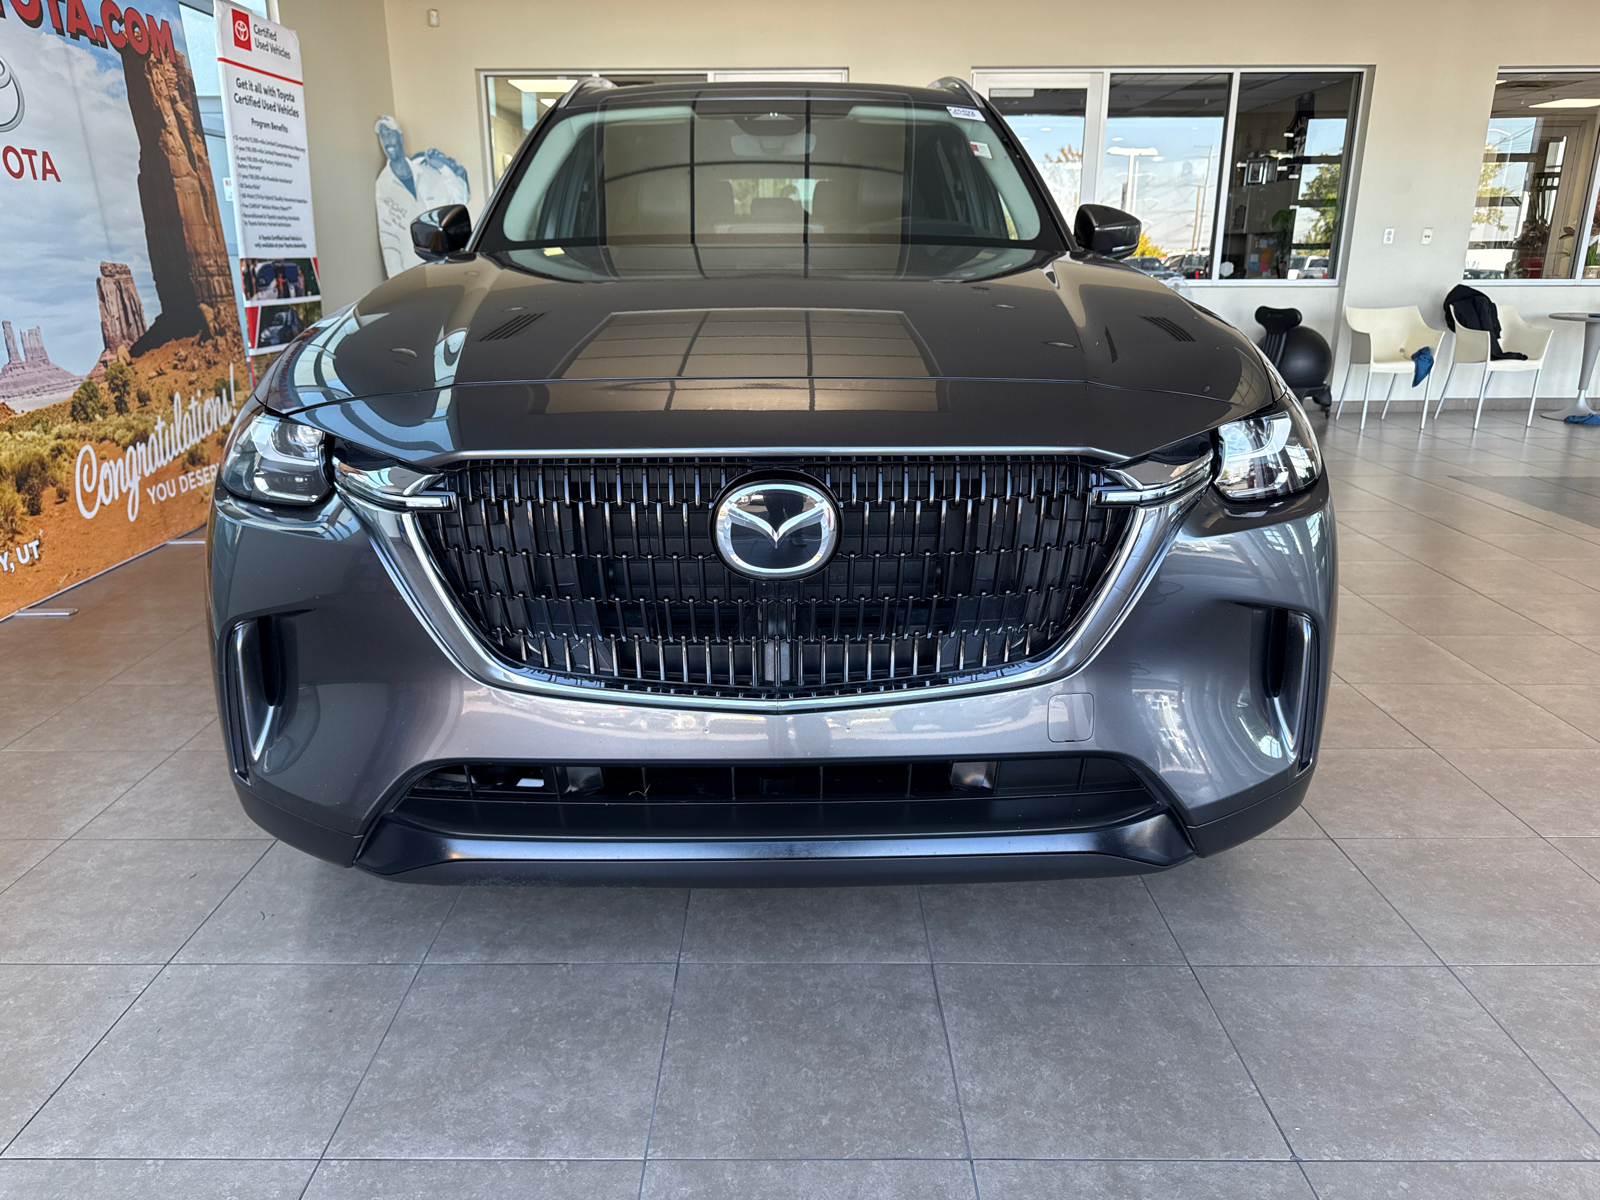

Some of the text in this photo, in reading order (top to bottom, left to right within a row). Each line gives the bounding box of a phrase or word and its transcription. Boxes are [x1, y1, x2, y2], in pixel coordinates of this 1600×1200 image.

[253, 24, 278, 41] Certified
[254, 38, 291, 60] Used Vehicles
[235, 77, 295, 103] Get it all with Toyota
[233, 92, 300, 118] Certified Used Vehicles
[251, 117, 289, 133] Program Benefits
[75, 362, 238, 522] Congratulations!
[146, 478, 177, 505] YOU
[15, 539, 40, 565] UT
